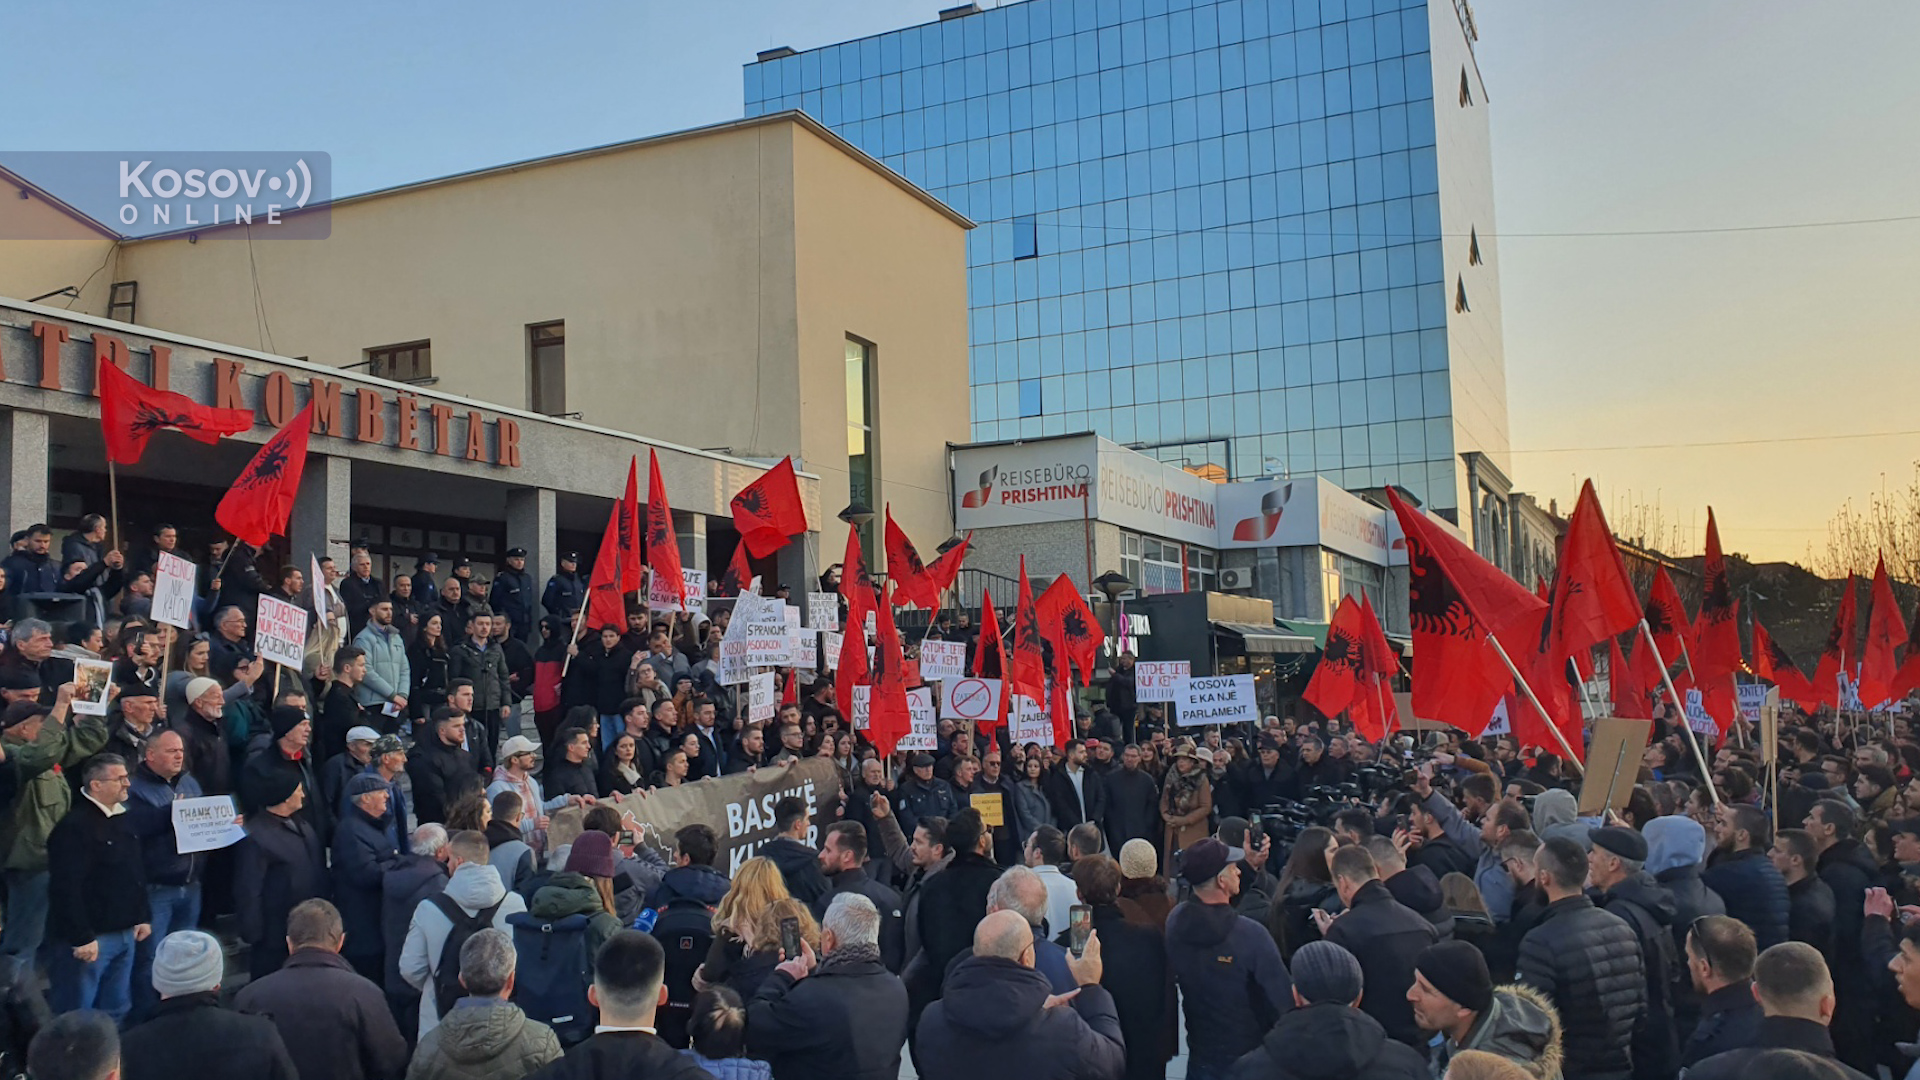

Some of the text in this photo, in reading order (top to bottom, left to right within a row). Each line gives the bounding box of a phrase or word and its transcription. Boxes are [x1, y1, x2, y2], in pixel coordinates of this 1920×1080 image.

[0, 320, 522, 468] TRI KOMBËTAR
[1001, 463, 1090, 487] REISEBÜRO
[1001, 484, 1089, 505] PRISHTINA
[1101, 466, 1217, 531] REISEBÜRO PRISHTINA
[260, 598, 307, 631] STUDENTET
[923, 642, 945, 654] ATDHE
[922, 653, 937, 665] NUK
[1138, 663, 1165, 674] ATDHE
[1137, 675, 1153, 686] NUK
[1190, 679, 1236, 691] KOSOVA
[1190, 695, 1197, 704] E
[1200, 693, 1215, 703] KA
[1182, 705, 1247, 719] PARLAMENT
[179, 804, 234, 822] THANK YOU
